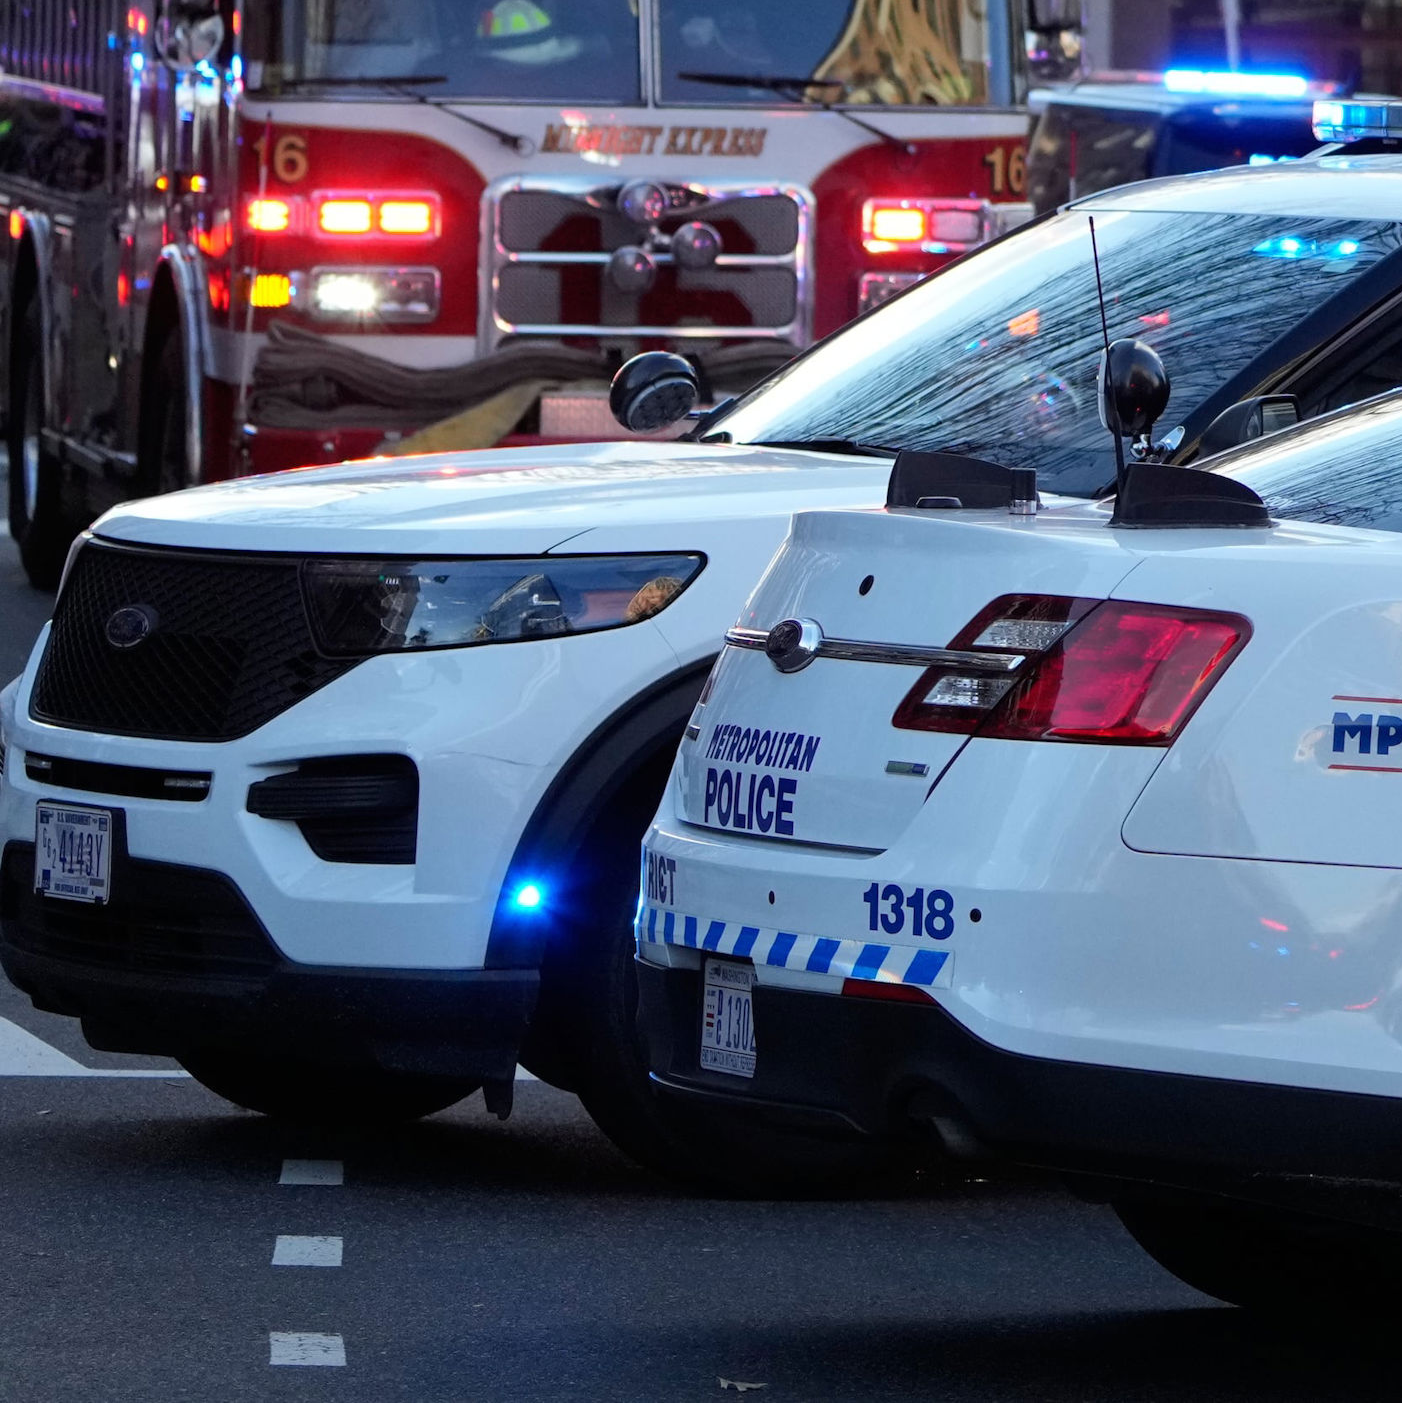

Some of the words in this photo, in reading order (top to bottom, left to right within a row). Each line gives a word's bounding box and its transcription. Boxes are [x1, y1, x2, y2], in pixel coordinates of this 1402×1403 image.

[663, 126, 767, 157] EXPRESS
[984, 146, 1026, 193] 16
[705, 724, 821, 773] METROPOLITAN
[704, 768, 798, 836] POLICE
[646, 847, 676, 906] RICT
[863, 882, 955, 940] 1318
